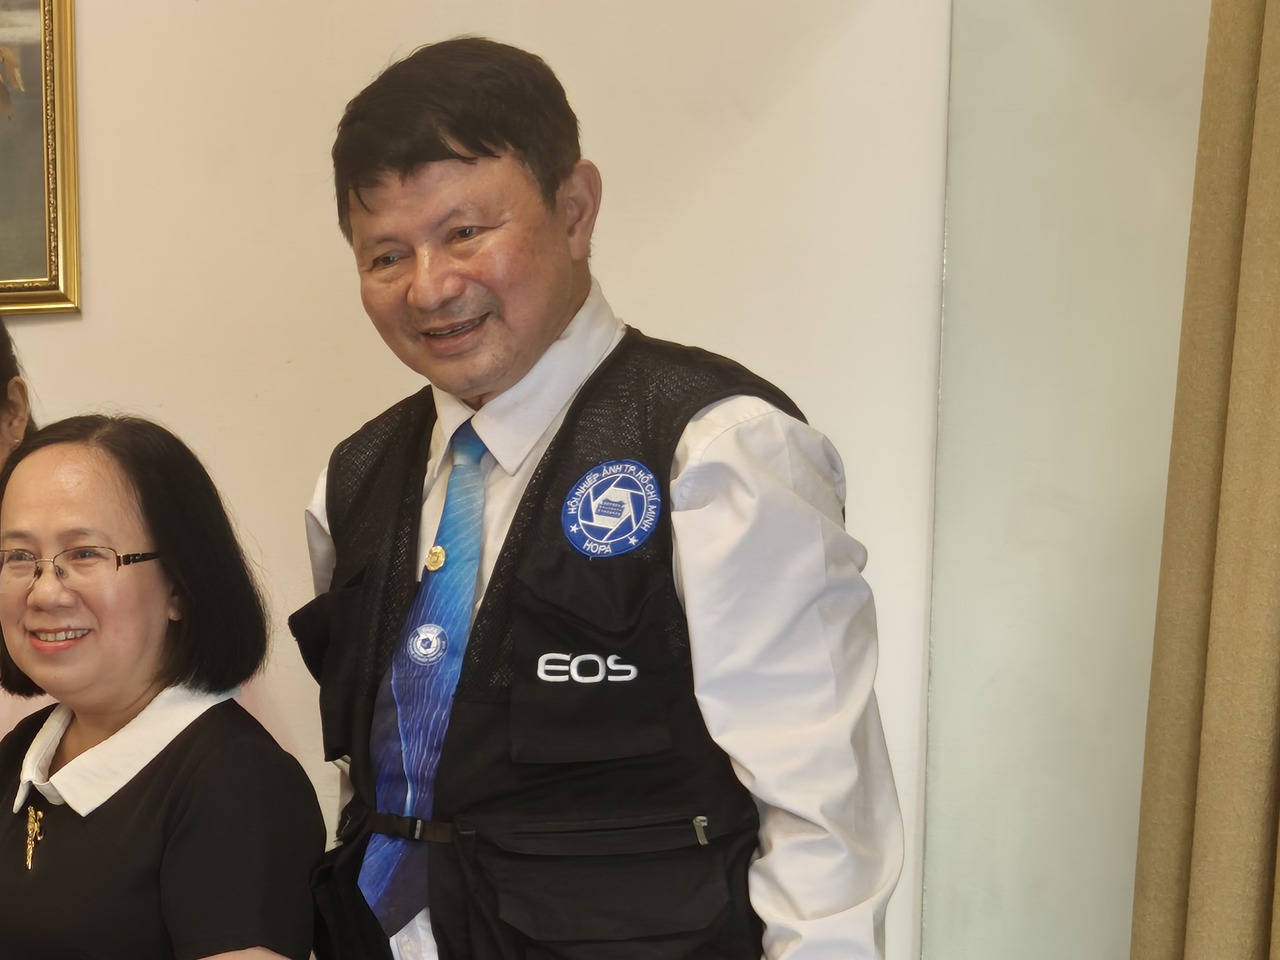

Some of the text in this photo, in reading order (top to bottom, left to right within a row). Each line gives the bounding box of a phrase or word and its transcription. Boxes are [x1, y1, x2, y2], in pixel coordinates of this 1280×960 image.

[640, 505, 657, 532] MINH
[582, 539, 612, 554] HOPA
[536, 652, 638, 684] EOS
